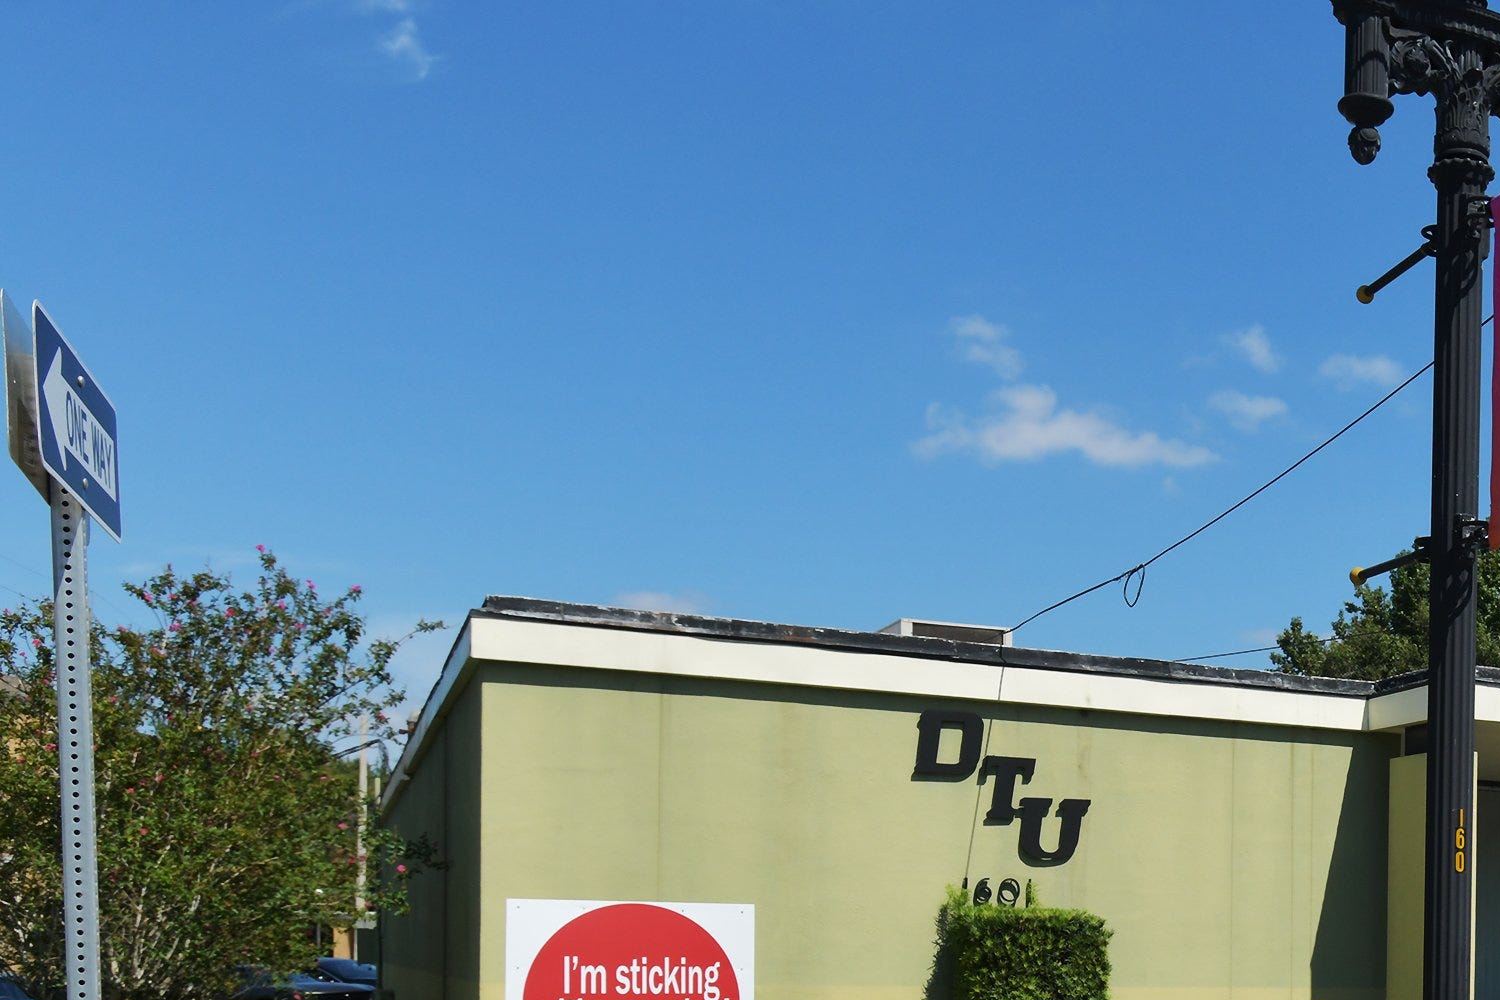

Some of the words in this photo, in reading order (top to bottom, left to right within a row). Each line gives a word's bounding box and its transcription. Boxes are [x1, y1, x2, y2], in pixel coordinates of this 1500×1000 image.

[65, 390, 90, 465] ONE
[90, 420, 113, 490] WAY
[911, 709, 1091, 868] DTU
[1455, 808, 1465, 873] 160
[563, 955, 607, 995] I'm
